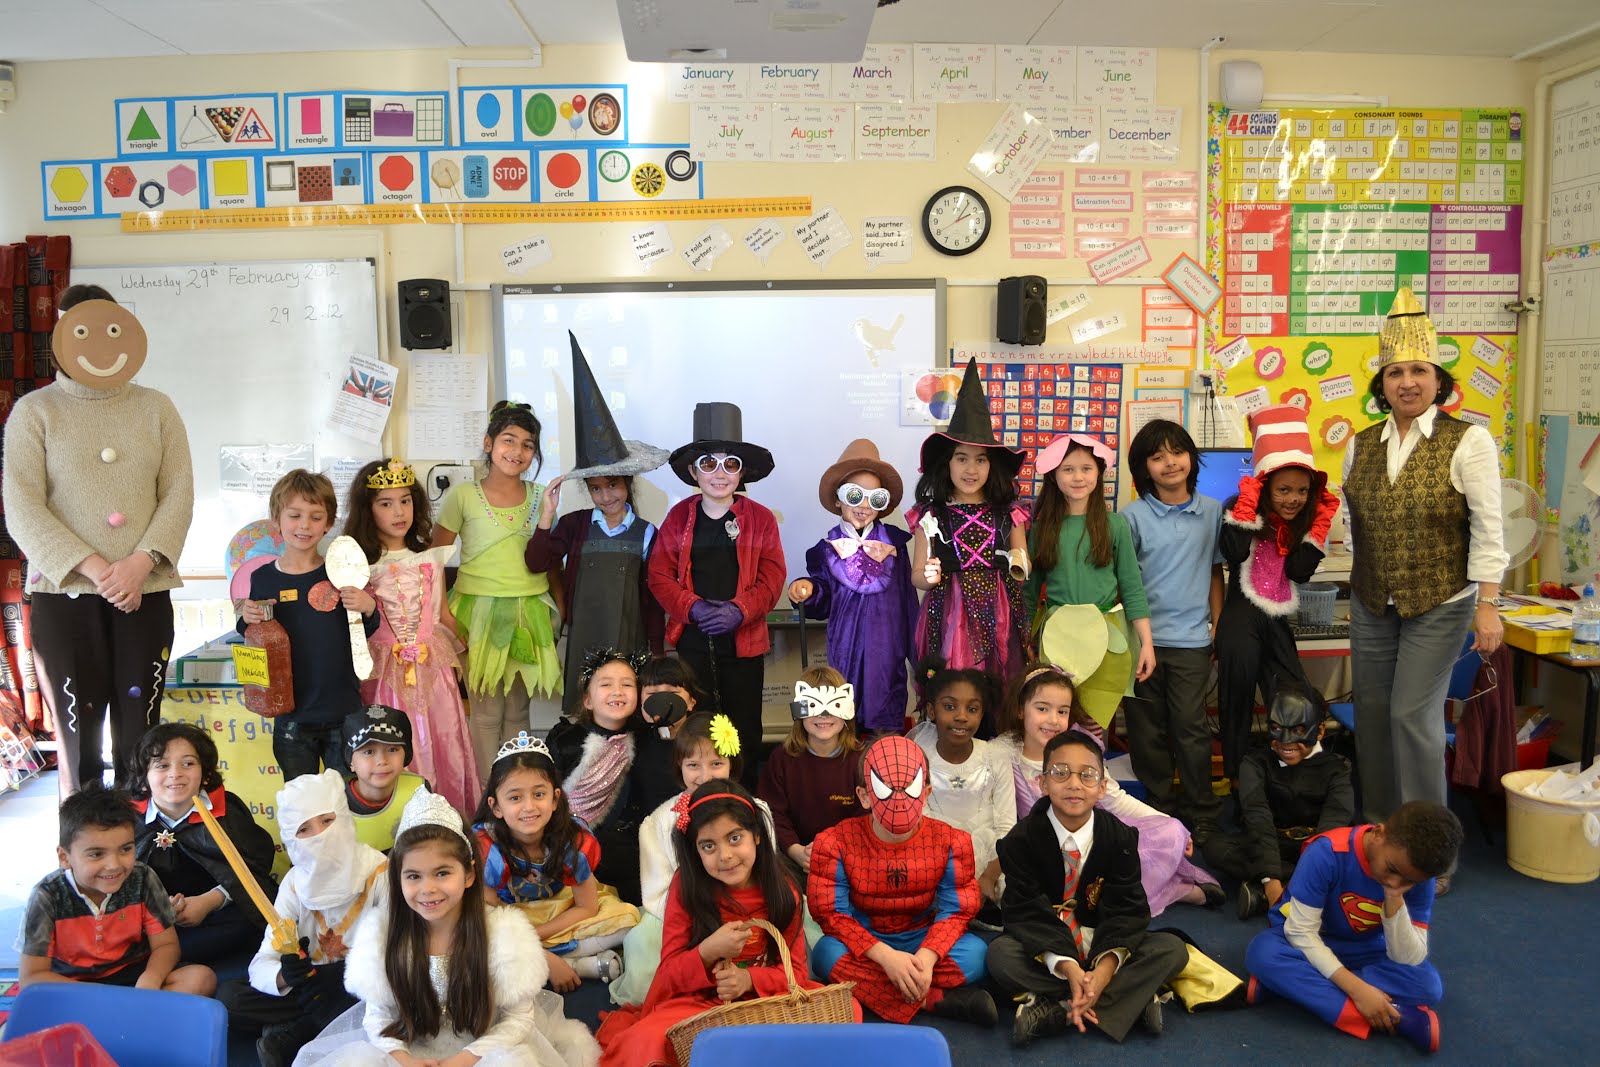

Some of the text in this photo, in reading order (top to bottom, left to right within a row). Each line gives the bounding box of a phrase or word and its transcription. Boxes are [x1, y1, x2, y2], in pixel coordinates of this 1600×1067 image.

[682, 66, 734, 82] January
[760, 65, 819, 81] February
[852, 66, 892, 79] March
[940, 67, 969, 79] April
[1022, 67, 1049, 83] May
[1102, 69, 1132, 82] June
[1227, 114, 1248, 134] 44
[1250, 114, 1277, 124] SOUNDS
[480, 129, 498, 138] oval
[718, 125, 744, 141] July
[790, 127, 834, 142] August
[861, 125, 931, 141] September
[1051, 127, 1092, 139] ember
[1108, 127, 1171, 141] December
[1250, 125, 1276, 135] CHART
[1382, 124, 1392, 133] ph
[1445, 124, 1455, 132] wh
[129, 140, 158, 150] triangle
[295, 135, 329, 146] rectangle
[994, 129, 1029, 176] October
[494, 166, 527, 182] STOP
[382, 191, 413, 202] octagon
[554, 189, 575, 198] circle
[54, 203, 88, 213] hexagon
[219, 198, 245, 207] square
[796, 227, 806, 236] My
[807, 212, 830, 229] partner
[1414, 217, 1427, 227] eigh
[639, 229, 655, 240] know
[802, 234, 813, 243] and
[503, 250, 516, 258] Can
[524, 242, 539, 250] take
[691, 242, 702, 253] told
[703, 235, 712, 244] my
[807, 235, 830, 252] decided
[866, 241, 898, 249] disagreed
[507, 257, 523, 268] risk?
[1093, 245, 1142, 271] Can you make up
[1382, 258, 1392, 268] igh
[1099, 255, 1137, 278] addition facts?
[121, 274, 181, 295] Wednesday
[228, 267, 300, 288] February
[304, 263, 339, 281] 2012
[1183, 266, 1212, 295] Doubles and
[1378, 279, 1394, 289] ough
[1183, 279, 1199, 297] Halves
[1499, 319, 1516, 329] augh
[1224, 343, 1242, 358] treat
[1480, 342, 1496, 356] read
[1262, 355, 1277, 372] does
[1307, 352, 1328, 366] where
[1043, 368, 1049, 376] 6
[1059, 367, 1065, 375] 7
[1320, 380, 1352, 394] phantom
[1472, 369, 1499, 392] alphabet
[1023, 384, 1033, 392] 15
[1041, 384, 1052, 392] 16
[1093, 386, 1102, 394] 19
[1244, 394, 1261, 404] seat
[1056, 402, 1067, 410] 27
[1091, 403, 1102, 411] 29
[1023, 418, 1115, 429] 35 37 39 40
[1461, 413, 1488, 427] phonics
[1577, 412, 1600, 426] Britai
[1329, 424, 1345, 441] after
[1020, 484, 1030, 492] 75
[206, 690, 220, 704] E
[221, 690, 233, 705] F
[213, 716, 273, 742] e f g h
[250, 801, 275, 820] big
